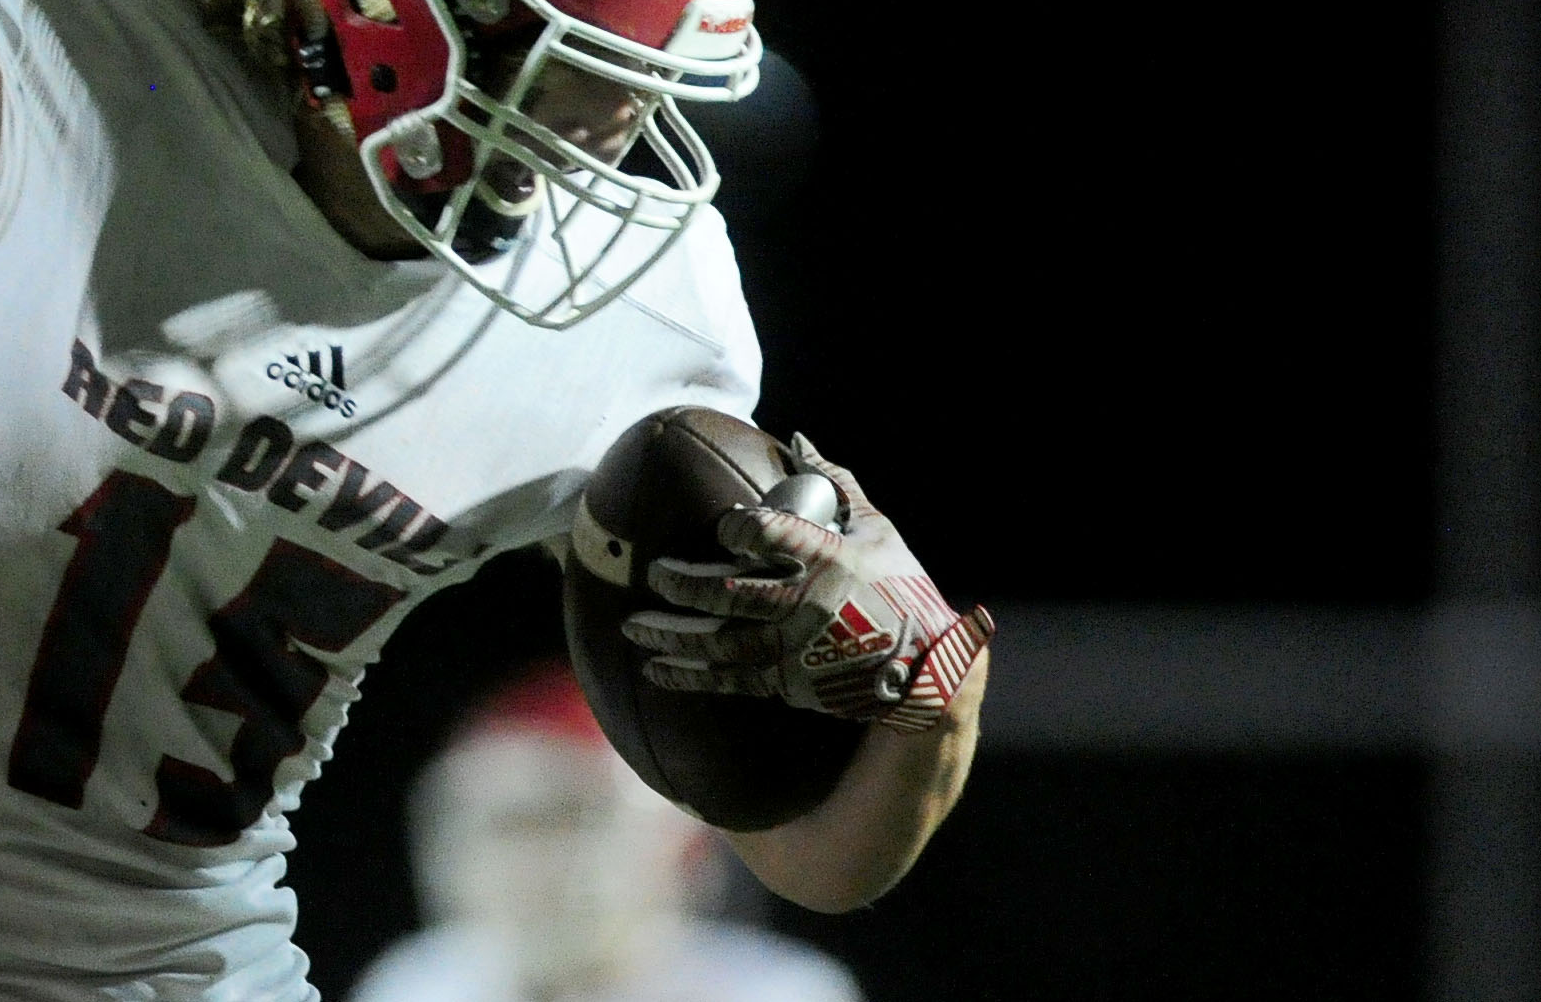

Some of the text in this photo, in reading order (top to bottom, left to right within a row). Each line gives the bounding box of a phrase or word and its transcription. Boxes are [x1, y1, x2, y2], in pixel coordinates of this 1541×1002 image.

[62, 337, 488, 576] RED DEVIL
[266, 363, 357, 418] adidas
[8, 468, 409, 848] 15
[804, 633, 892, 666] adidas
